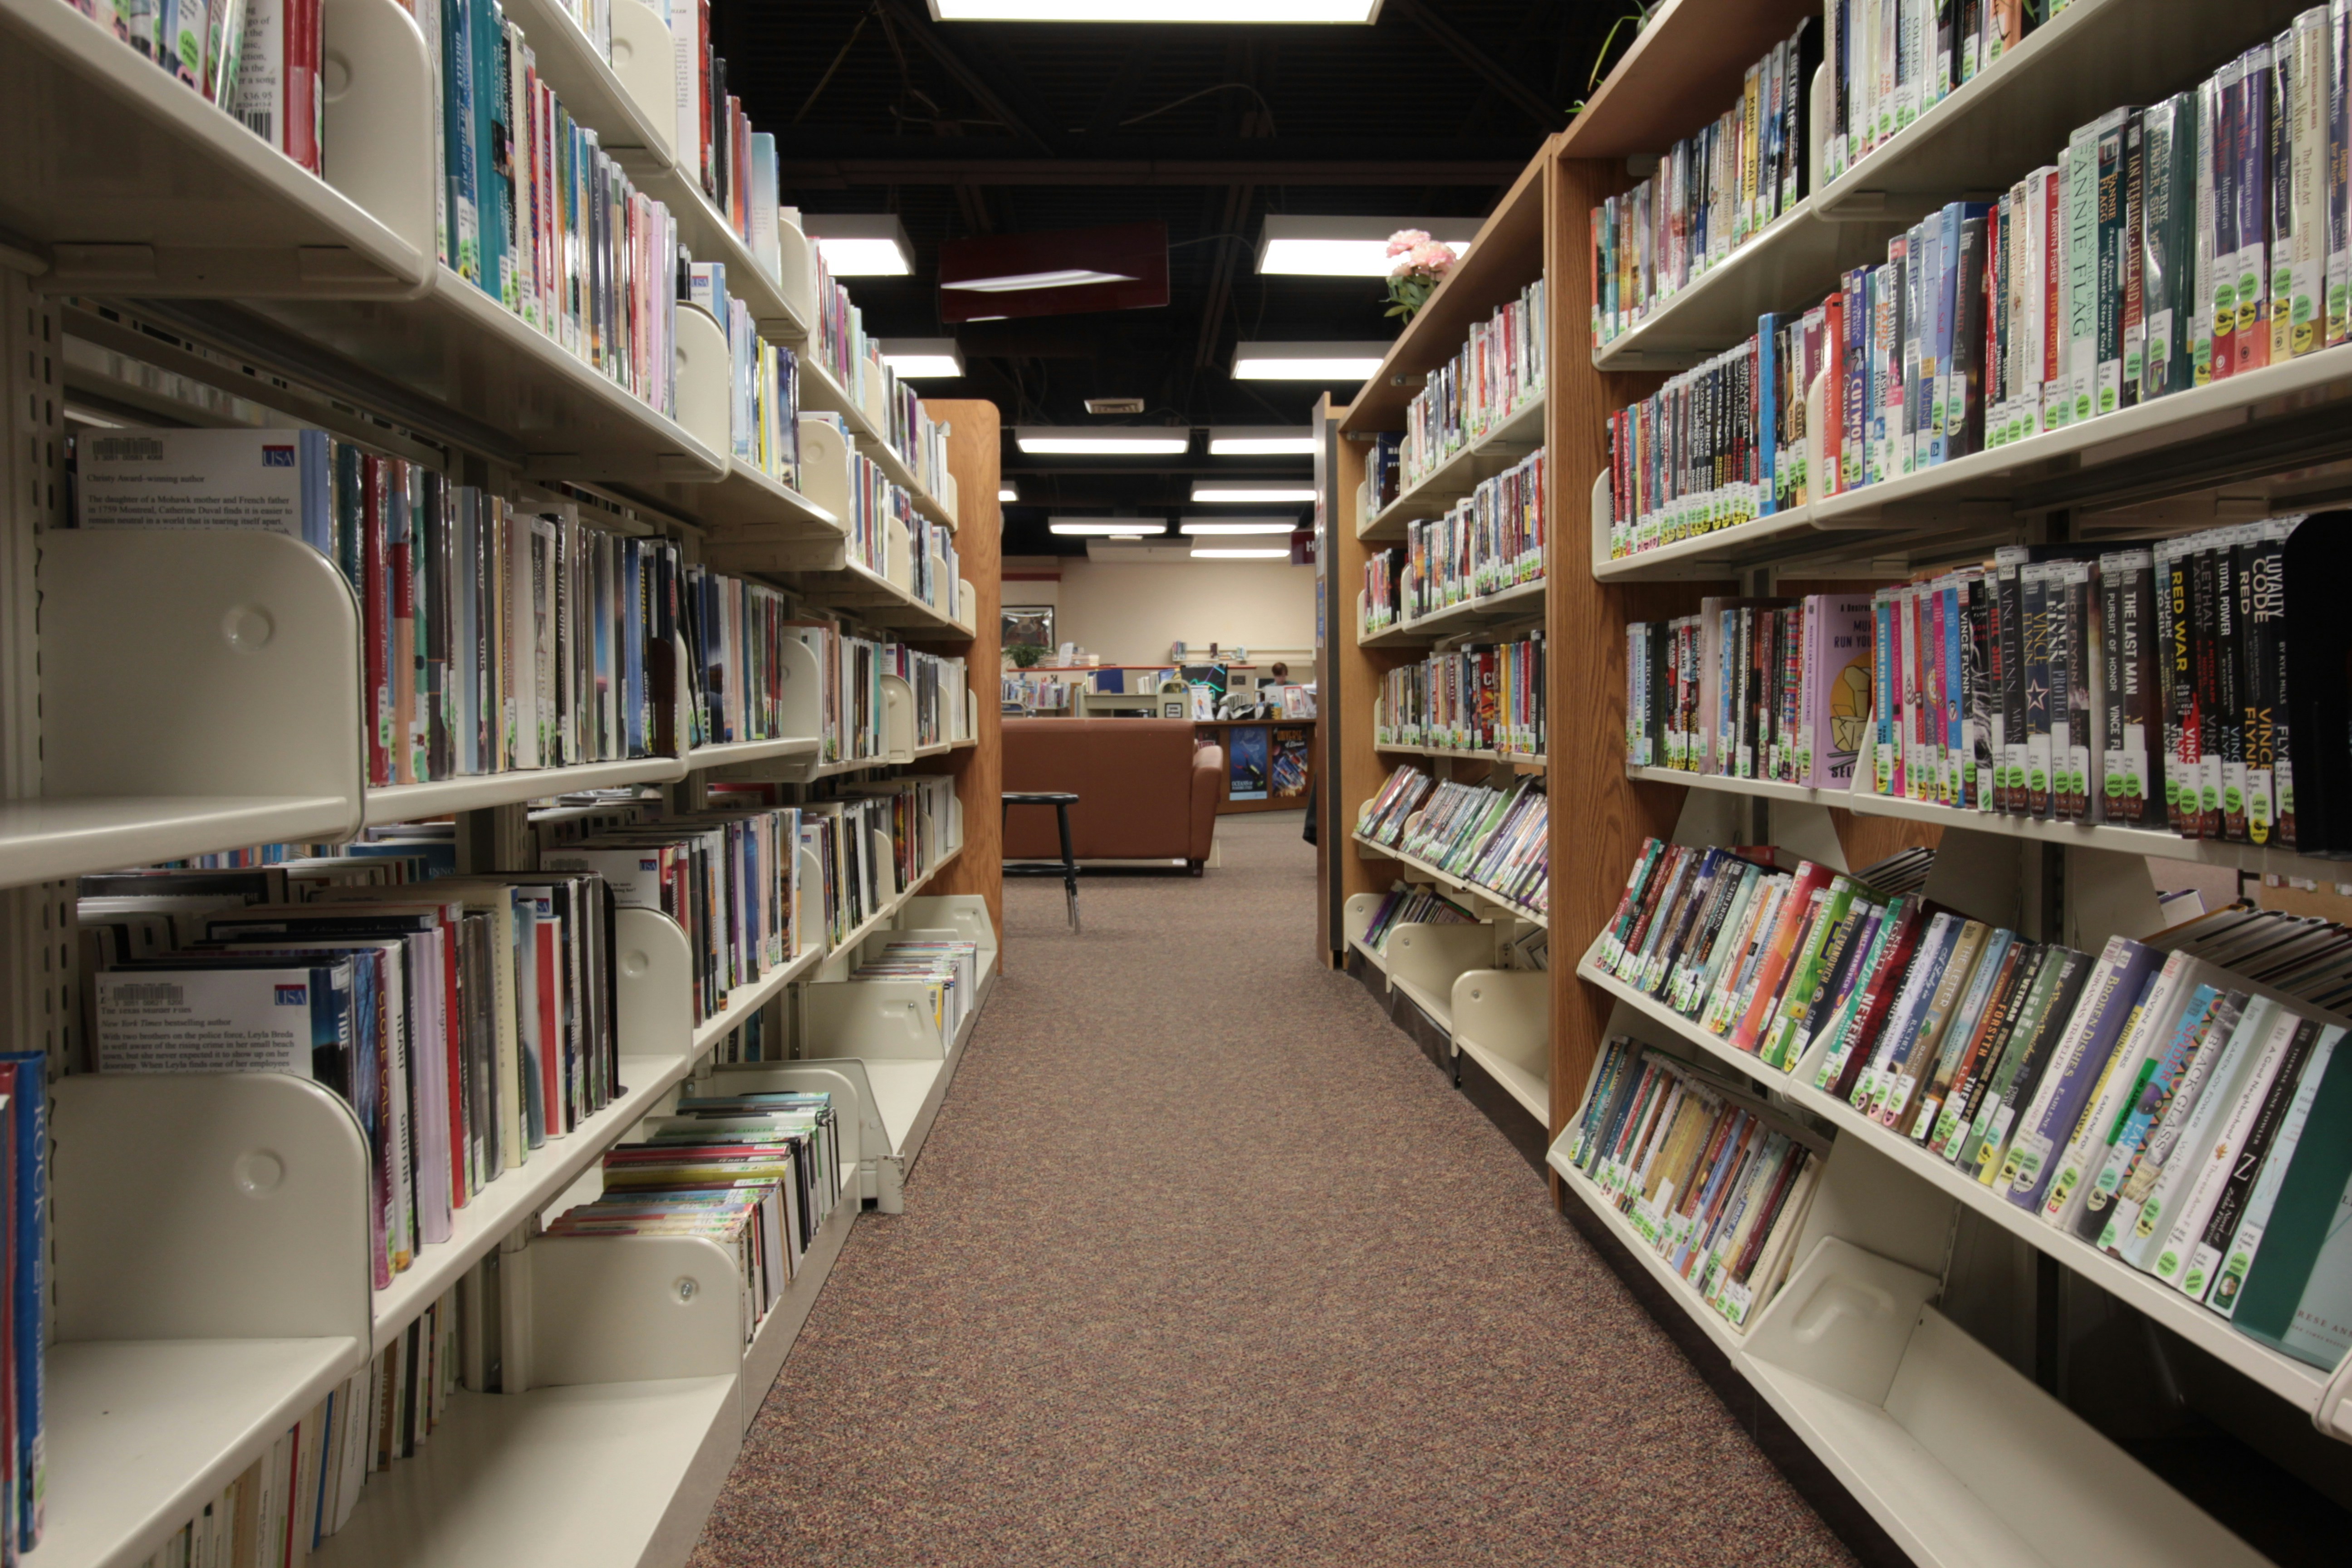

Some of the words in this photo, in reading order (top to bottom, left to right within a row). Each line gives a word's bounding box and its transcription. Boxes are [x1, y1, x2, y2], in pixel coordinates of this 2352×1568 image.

[2129, 153, 2141, 178] IAN
[2303, 148, 2312, 164] The
[2108, 172, 2118, 220] FANNIE
[2222, 176, 2230, 215] Murder
[2303, 167, 2312, 187] Fine
[2128, 180, 2141, 233] FLEMING
[2149, 197, 2159, 227] SHE
[2159, 175, 2169, 220] MERRY
[2303, 189, 2312, 205] Art
[2222, 218, 2230, 229] on
[2001, 284, 2008, 293] of
[2073, 262, 2086, 336] FLAG
[2127, 276, 2139, 303] AND
[2048, 314, 2057, 359] wrong
[263, 451, 294, 466] USA
[87, 474, 115, 483] Christy
[105, 495, 137, 506] daughter
[2172, 571, 2184, 613] RED
[2201, 560, 2213, 632] LETHAL
[2219, 560, 2229, 594] TOTAL
[2240, 571, 2250, 615] RED
[2253, 559, 2269, 623] CODE
[2003, 588, 2015, 635] VINCE
[2107, 593, 2115, 634] PURSUIT
[2124, 592, 2136, 618] THE
[2193, 567, 2202, 627] AGENT
[2220, 596, 2230, 636] POWER
[1834, 636, 1852, 647] RUN
[1857, 636, 1871, 647] YOU
[1960, 612, 1969, 652] VINCE
[2023, 613, 2033, 666] FLYNN
[2033, 612, 2048, 664] VINCE
[2108, 639, 2116, 652] OF
[2125, 622, 2137, 657] LAST
[2175, 620, 2189, 671] WAR
[2279, 642, 2286, 653] BY
[2004, 642, 2016, 692] FLYNN
[2109, 657, 2117, 691] HONOR
[2125, 662, 2137, 695] MAN
[1277, 730, 1302, 740] UNIVERSE
[2245, 707, 2257, 771] FLYNN
[2259, 708, 2273, 770] VINCE
[640, 862, 657, 871] USA
[1876, 921, 1902, 974] FOLLETT
[1888, 936, 1902, 960] KEN
[1958, 945, 1973, 965] THE
[275, 990, 306, 1004] USA
[1939, 968, 1960, 1007] LETTER
[2006, 978, 2031, 1022] VETERAN
[2078, 968, 2104, 1019] ARKANSAS
[2084, 974, 2120, 1029] BROKEN
[2142, 986, 2164, 1024] SEVEN
[165, 1019, 204, 1027] bestselling
[338, 1012, 348, 1051] TIDE
[379, 991, 387, 1062] CLOSE
[1847, 992, 1875, 1046] NEVER
[1978, 1004, 2006, 1056] FORSYTH
[2112, 1011, 2138, 1058] CARDINAL
[397, 1015, 406, 1069] HEART
[2054, 1022, 2079, 1070] TRAVELER
[2065, 1031, 2094, 1077] DISHES
[2120, 1027, 2144, 1068] SISTERS
[2161, 1022, 2196, 1082] SPIDER
[2221, 1041, 2238, 1071] KAREN
[2187, 1035, 2220, 1091] BLACK
[2211, 1074, 2222, 1089] JOY
[2259, 1057, 2271, 1078] Good
[2281, 1048, 2299, 1084] THERESE
[2120, 1089, 2139, 1127] PROPERTY
[2192, 1091, 2213, 1129] FOWLER
[2226, 1081, 2259, 1140] Neighborhood
[2270, 1086, 2282, 1108] ANNE
[2155, 1096, 2187, 1152] GLASS
[2254, 1111, 2272, 1145] FOWLER
[34, 1105, 44, 1223] ROCK
[400, 1114, 409, 1183] GRIFFIN
[2234, 1152, 2257, 1181] Z
[2158, 1263, 2171, 1274] PRINT
[2161, 1255, 2176, 1267] LARGE
